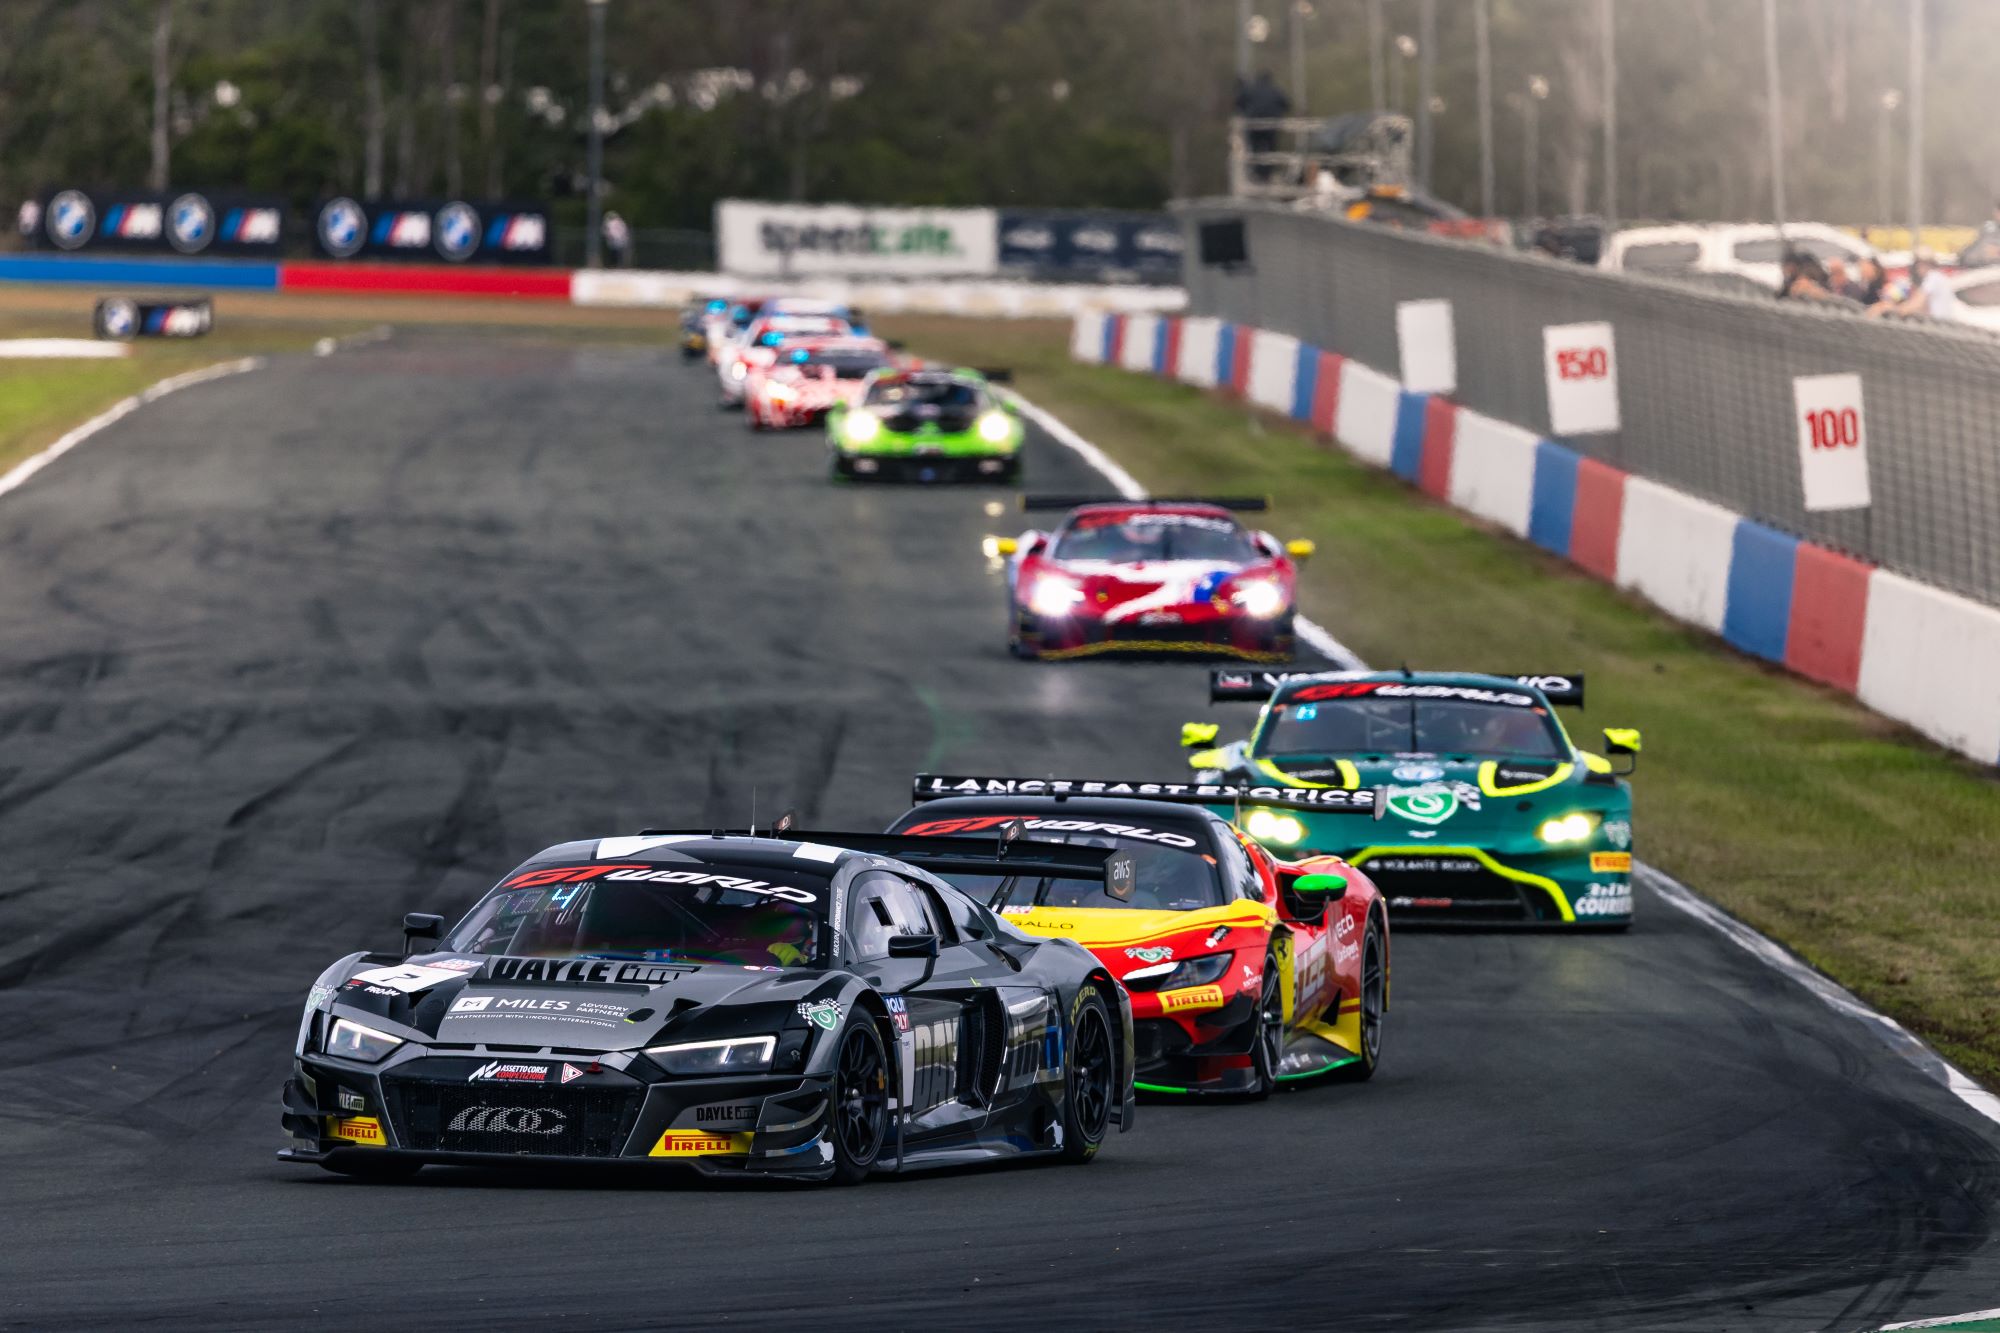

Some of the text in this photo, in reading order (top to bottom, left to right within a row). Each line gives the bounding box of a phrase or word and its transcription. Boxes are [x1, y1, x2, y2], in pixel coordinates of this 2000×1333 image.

[1556, 348, 1607, 380] 150
[1806, 408, 1858, 449] 100
[1081, 781, 1189, 795] EAST
[903, 815, 1197, 848] GT WORLD
[1113, 859, 1131, 880] aws
[502, 865, 818, 903] GT WORLD
[489, 957, 615, 983] DAYLE
[495, 998, 571, 1011] MILES
[579, 1002, 629, 1012] ADVISORY
[1166, 989, 1219, 1008] PIRELLI
[575, 1007, 625, 1018] PARTNERS
[558, 1016, 616, 1029] INTERNATIONAL
[496, 1071, 546, 1080] COMPETIZIONE
[500, 1064, 549, 1074] ASSETTO CORSA
[696, 1105, 734, 1122] DAYLE
[338, 1119, 378, 1139] PIRELLI
[664, 1134, 732, 1151] PIRELLI
